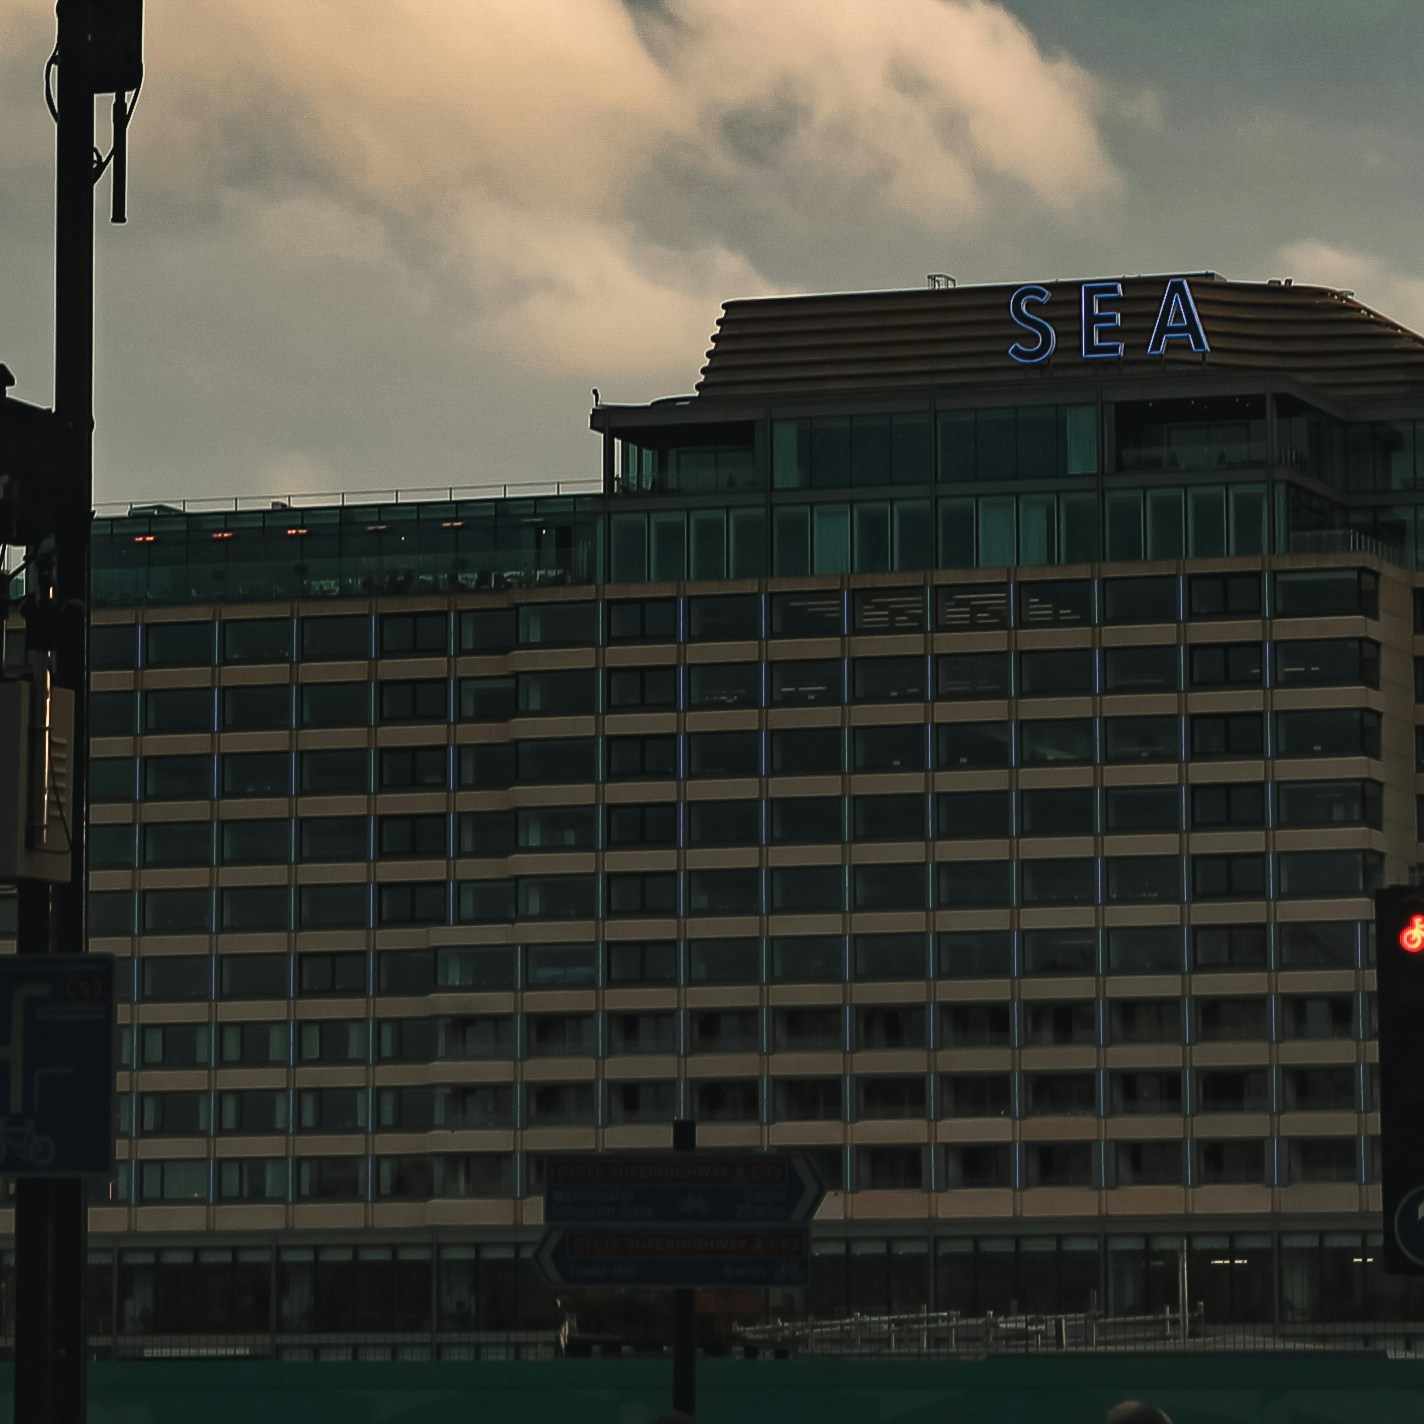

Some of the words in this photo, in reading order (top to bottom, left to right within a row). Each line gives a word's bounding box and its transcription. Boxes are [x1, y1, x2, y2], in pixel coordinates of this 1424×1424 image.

[1007, 278, 1211, 365] SEA
[66, 980, 102, 997] CS3
[558, 1165, 601, 1178] CYCLE
[608, 1165, 729, 1178] SUPERHIGHWAY
[755, 1205, 787, 1217] mins
[573, 1239, 621, 1251] CYCLE
[626, 1238, 746, 1251] SUPERHIGHWAY
